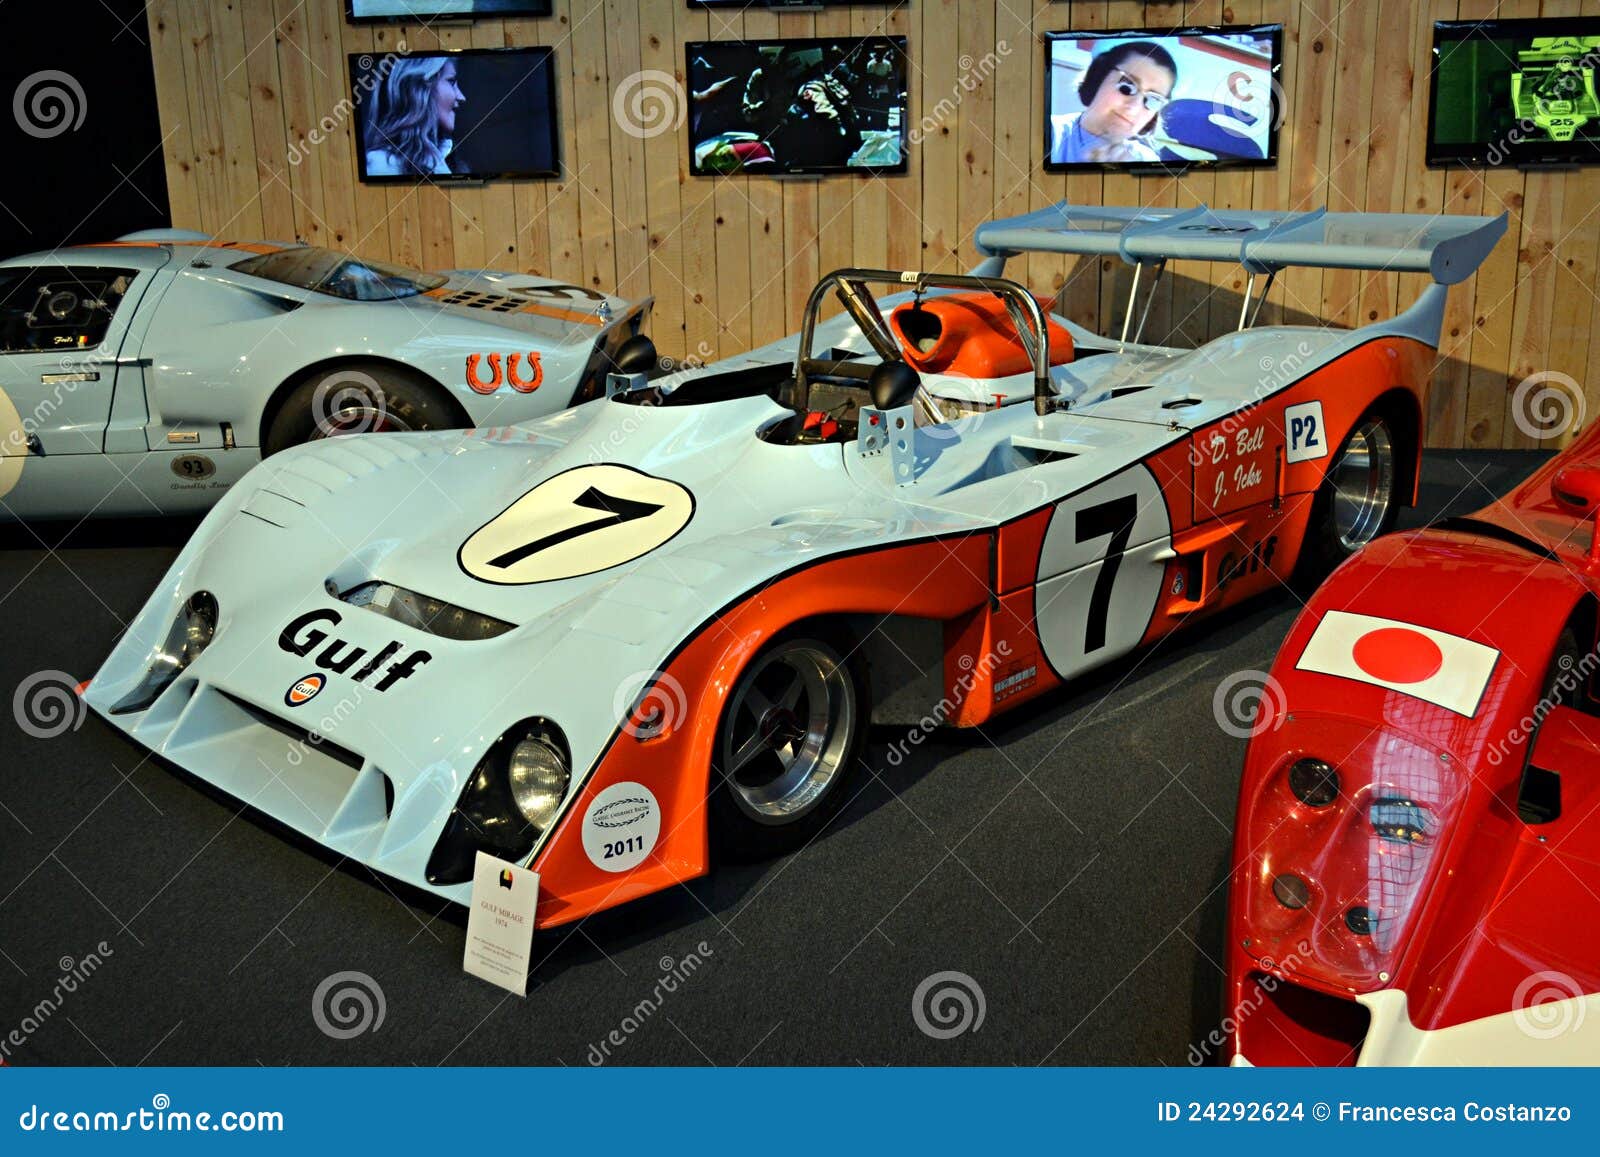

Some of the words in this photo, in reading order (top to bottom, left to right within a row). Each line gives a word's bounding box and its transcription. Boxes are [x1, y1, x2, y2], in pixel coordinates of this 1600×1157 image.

[1550, 118, 1575, 126] 25
[1236, 425, 1264, 456] Bell
[1291, 415, 1319, 450] P2
[183, 460, 204, 474] 93
[1234, 461, 1262, 492] Ickx
[485, 485, 666, 569] 7
[1075, 493, 1138, 655] 7
[278, 608, 433, 692] Gulf
[294, 683, 316, 696] Gulf
[603, 836, 643, 859] 2011
